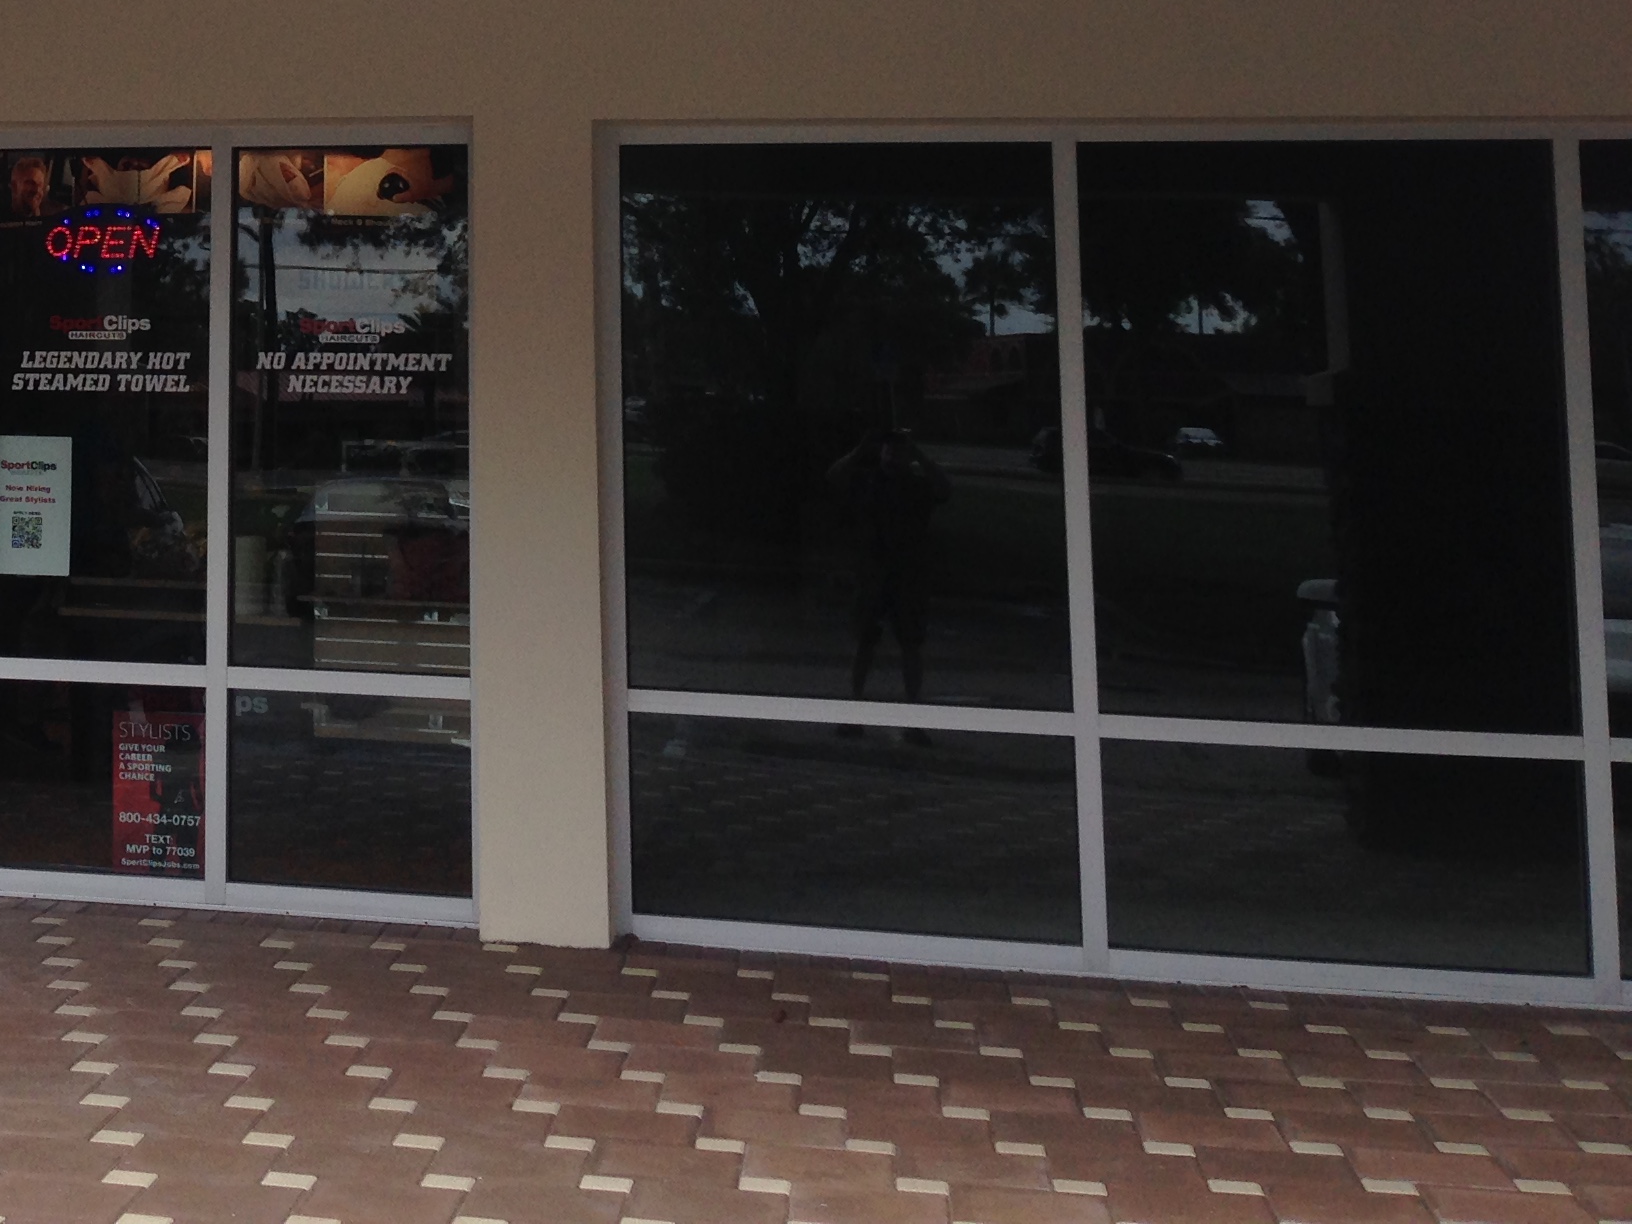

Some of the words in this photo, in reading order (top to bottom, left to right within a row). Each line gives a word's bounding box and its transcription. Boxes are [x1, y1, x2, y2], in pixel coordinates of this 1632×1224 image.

[45, 225, 161, 259] OPEN
[49, 315, 152, 333] SportClips
[299, 317, 406, 337] SportClips
[70, 331, 125, 339] HAIRCUTS
[20, 351, 143, 369] LEGENDARY
[146, 352, 191, 370] HOT
[256, 351, 287, 370] NO
[290, 352, 453, 372] APPOINTMENT
[11, 373, 110, 392] STEAMED
[116, 374, 191, 393] TOWEL
[287, 375, 413, 394] NECESSARY
[0, 459, 57, 472] SportClips
[119, 721, 192, 741] STYLISTS
[119, 743, 140, 752] GIVE
[141, 744, 166, 753] YOUR
[119, 752, 153, 762] CAREER
[119, 762, 126, 771] A
[127, 763, 172, 773] SPORTING
[119, 772, 156, 782] CHANCE
[119, 811, 201, 827] 800-434-0757
[126, 844, 150, 854] MVP
[152, 846, 163, 855] to
[166, 846, 196, 858] 77039
